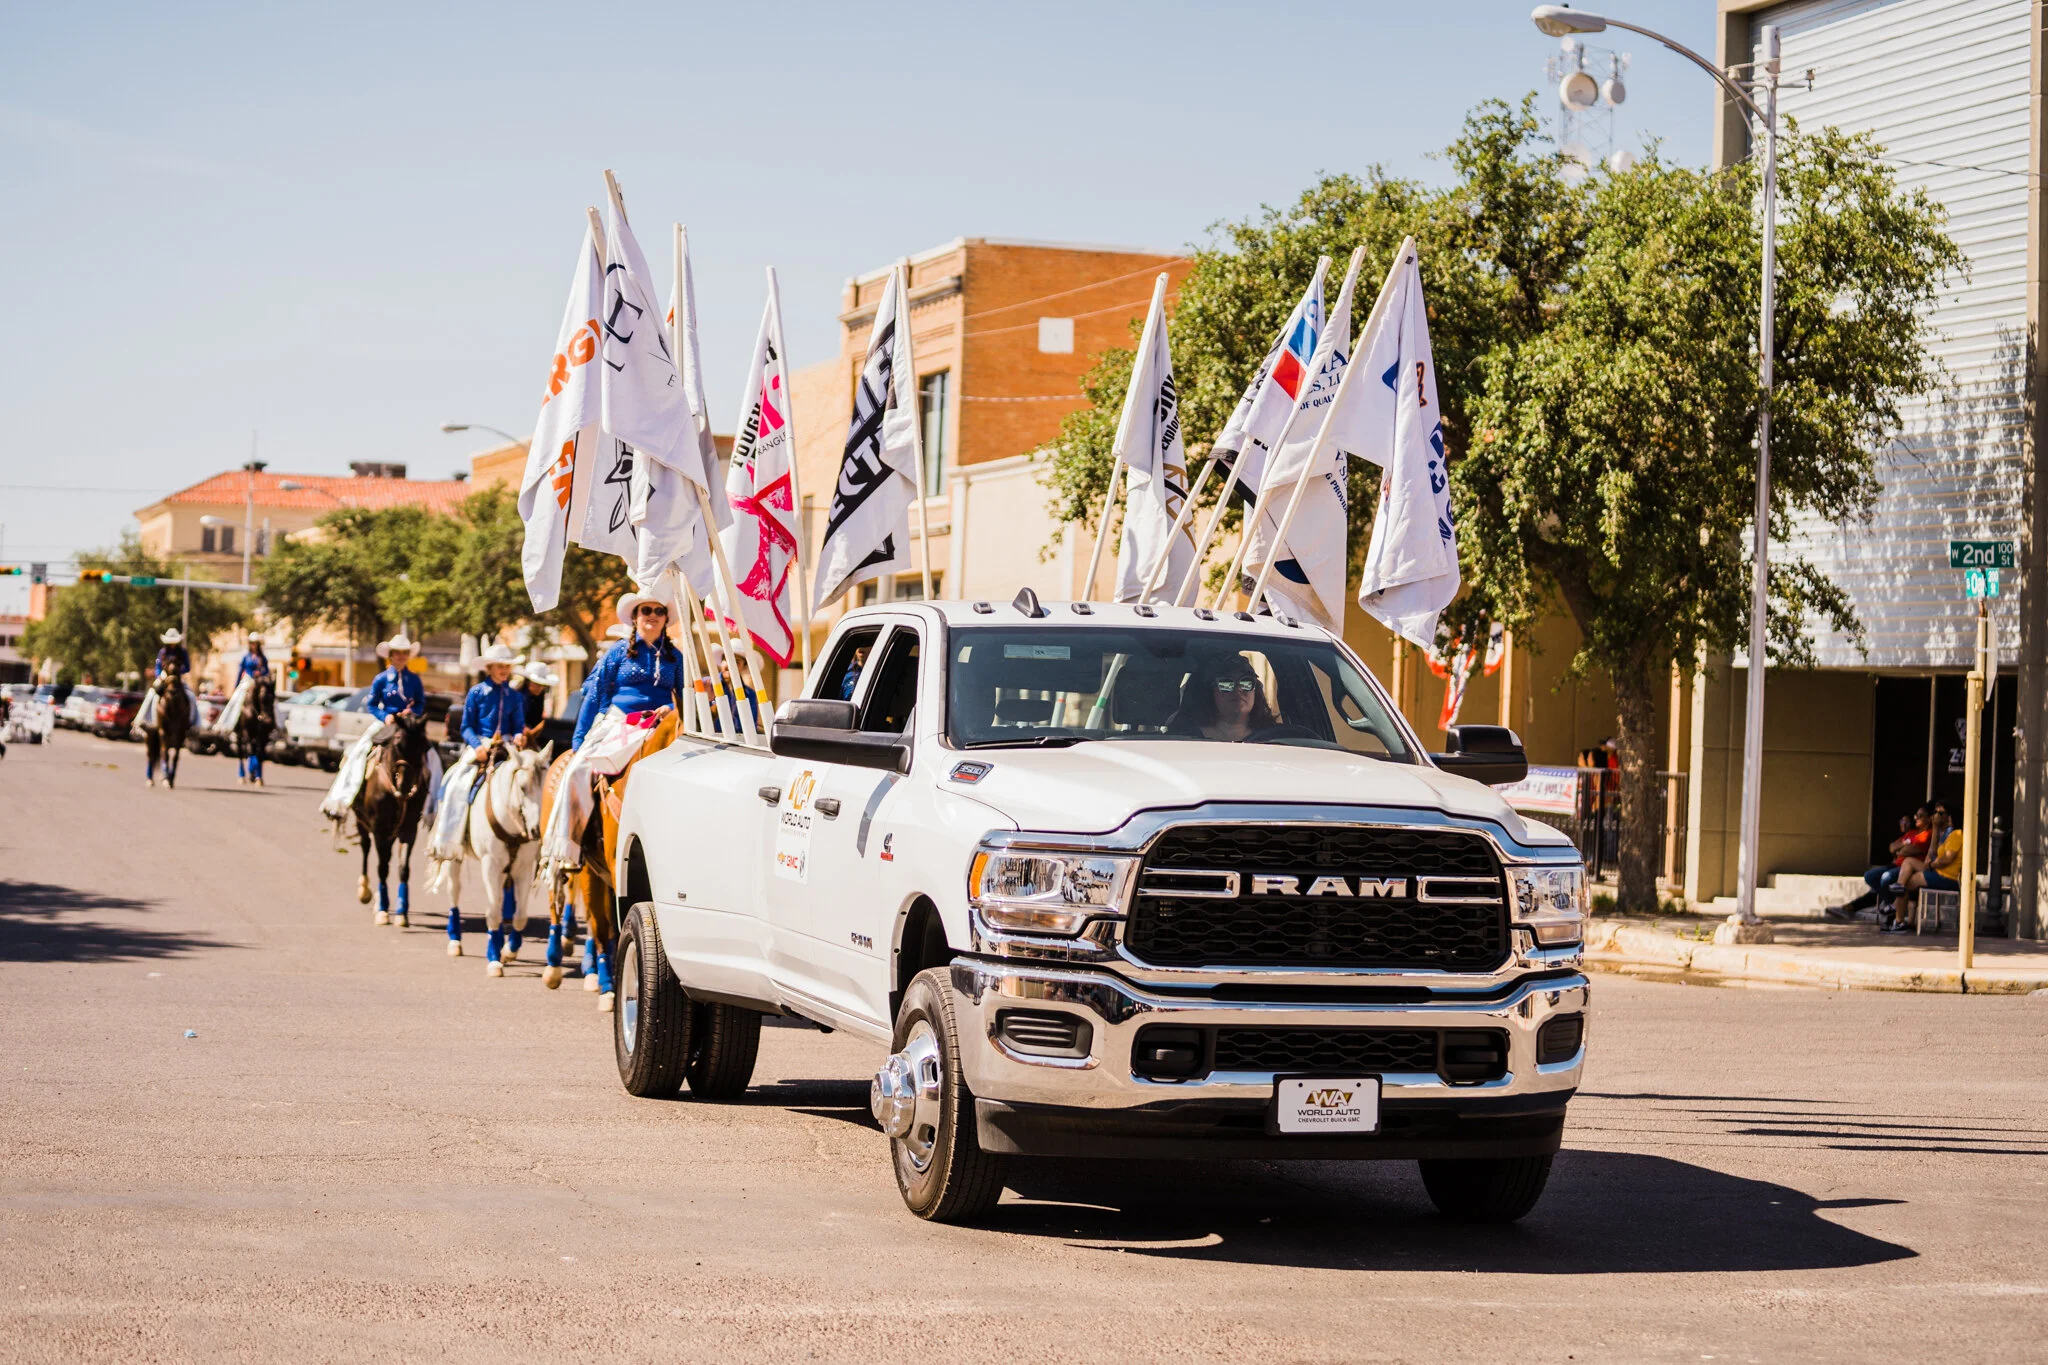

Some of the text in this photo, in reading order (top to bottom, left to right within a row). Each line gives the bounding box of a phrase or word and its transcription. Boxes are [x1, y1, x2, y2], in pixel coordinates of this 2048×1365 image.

[1951, 543, 2013, 564] W 2nd 100
[2001, 555, 2011, 566] St
[781, 811, 811, 830] WORLD AUTO
[786, 855, 799, 869] GMC
[1251, 873, 1408, 898] RAM
[1309, 1089, 1350, 1107] WA
[1334, 1108, 1361, 1116] AUTO
